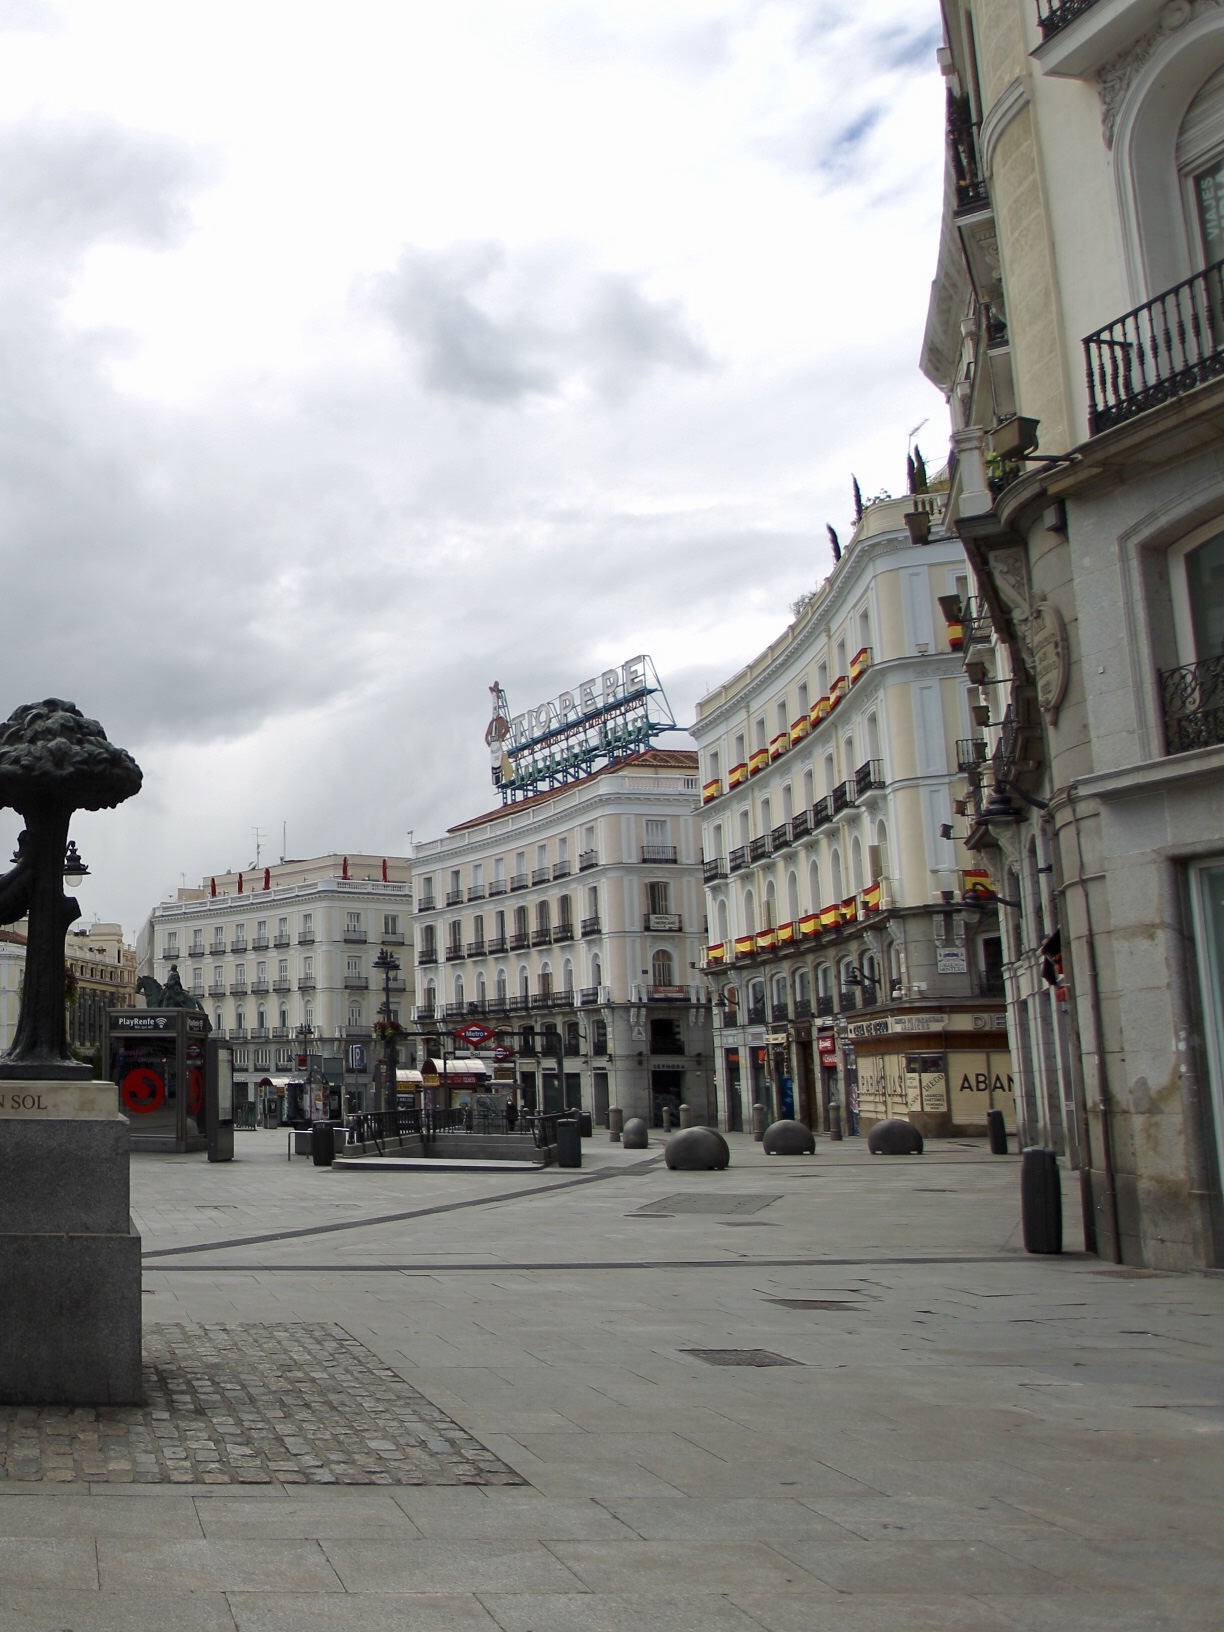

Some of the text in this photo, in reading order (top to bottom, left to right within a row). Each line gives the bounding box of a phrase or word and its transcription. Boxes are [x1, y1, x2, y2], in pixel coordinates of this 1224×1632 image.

[512, 655, 644, 746] TIO PEPE
[119, 1018, 154, 1027] PlayRenfe
[923, 1073, 945, 1092] DIEGO
[10, 1094, 48, 1110] SOL
